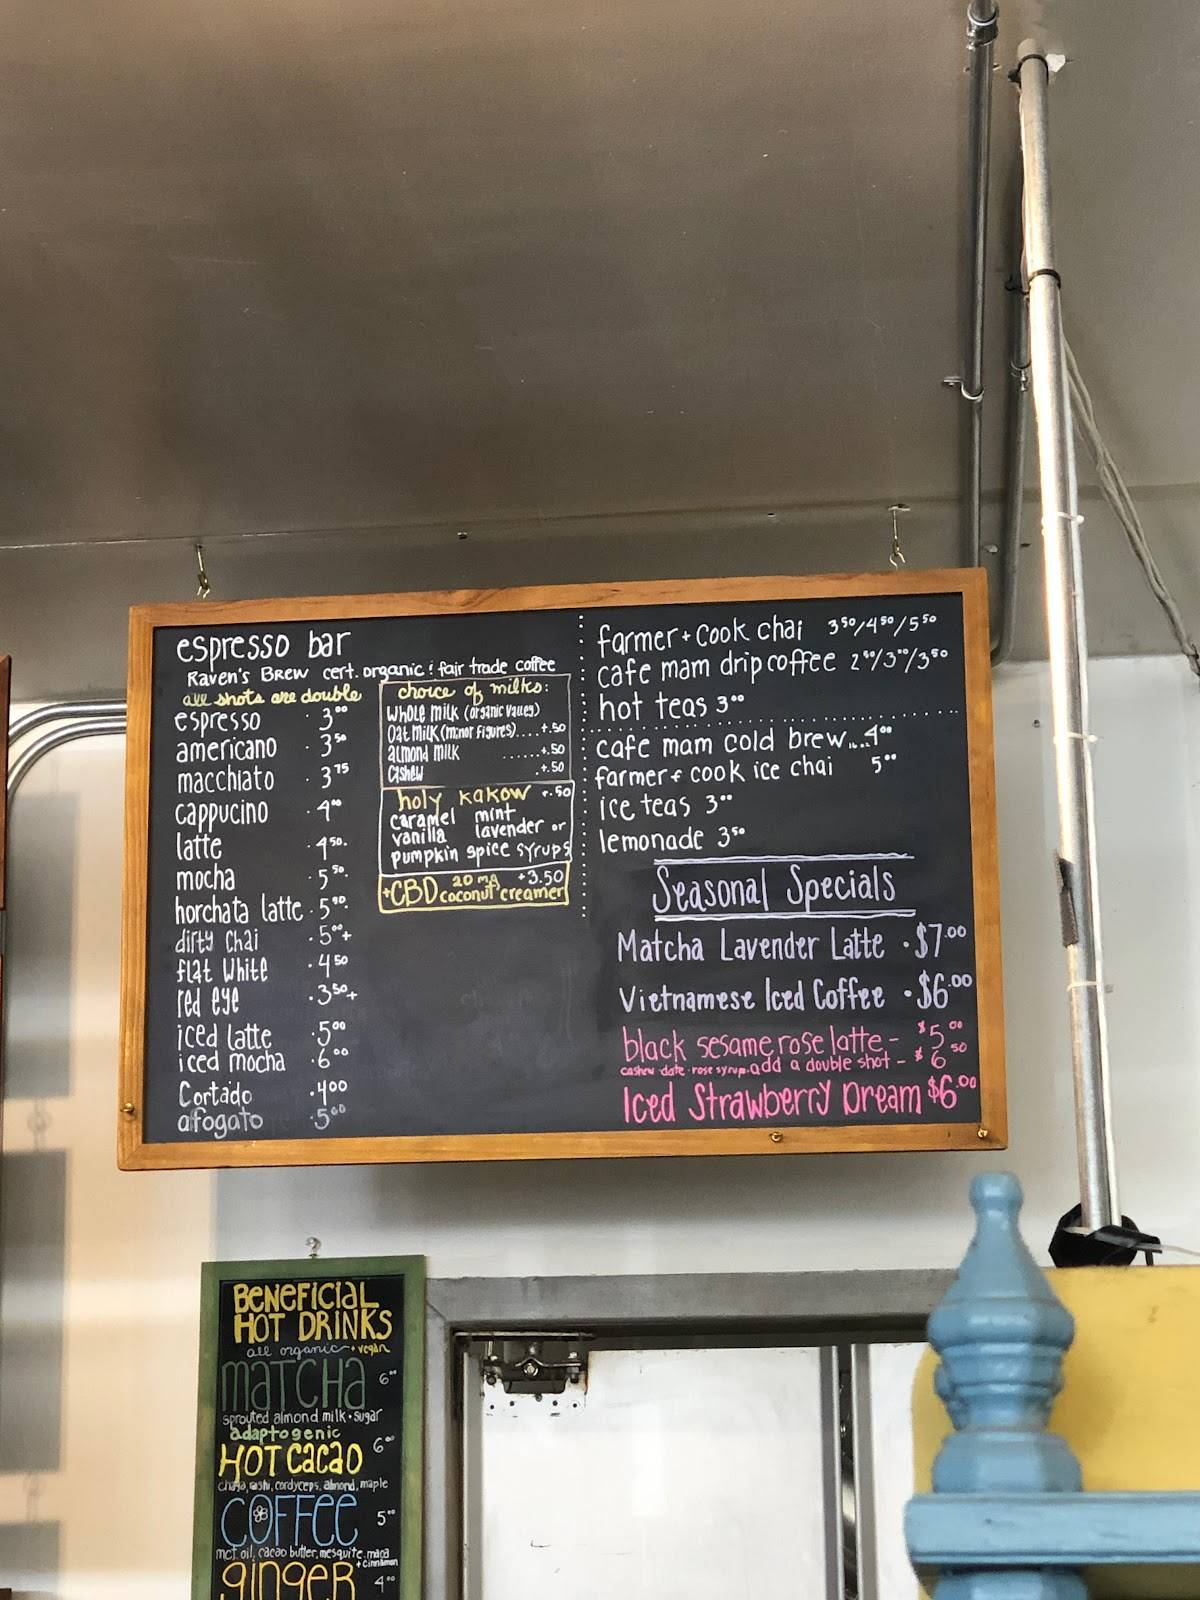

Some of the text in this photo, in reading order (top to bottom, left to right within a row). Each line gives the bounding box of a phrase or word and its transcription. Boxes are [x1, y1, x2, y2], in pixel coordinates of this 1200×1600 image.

[757, 615, 803, 641] chai
[177, 631, 351, 672] espresso bar
[188, 669, 250, 687] Raven's
[322, 662, 359, 680] cert.
[363, 663, 425, 683] organic
[438, 661, 464, 677] fair
[469, 657, 508, 674] trade
[515, 656, 556, 672] coffee
[598, 656, 652, 689] cafe
[662, 658, 710, 680] mam
[183, 683, 362, 707] all shots are double
[398, 681, 455, 700] choice
[464, 681, 484, 706] of
[599, 691, 643, 721] hot
[654, 691, 707, 719] teas
[175, 711, 260, 738] espresso
[177, 737, 277, 762] americano
[388, 744, 428, 763] almond
[596, 734, 650, 759] cafe
[662, 738, 713, 758] mam
[724, 727, 774, 753] cold
[789, 728, 848, 750] brew
[178, 764, 274, 793] macchiato
[753, 760, 780, 780] ice
[790, 755, 834, 777] chai
[175, 799, 268, 832] cappucino
[397, 789, 443, 818] holy
[459, 785, 532, 806] kakow
[600, 798, 636, 820] ice
[640, 793, 691, 817] teas
[390, 802, 516, 830] caramel mint
[392, 818, 566, 846] vanilla lavender or
[599, 827, 704, 853] lemonade
[177, 832, 222, 861] latte
[391, 841, 571, 870] pumpkin spice syrups
[177, 863, 235, 890] mocha
[452, 875, 473, 886] 20
[653, 864, 896, 914] Seasonal Specials
[439, 884, 495, 902] coconut
[500, 885, 563, 901] creamer
[175, 893, 303, 924] horchata latte
[175, 929, 214, 953] dirty
[618, 929, 705, 962] Matcha
[721, 927, 819, 961] Lavender
[832, 927, 885, 960] Latte
[176, 959, 212, 984] flat
[178, 986, 239, 1018] red eye
[619, 985, 755, 1013] Vietnamese
[766, 977, 805, 1011] Iced
[813, 977, 886, 1010] Coffee
[178, 1024, 217, 1050] iced
[227, 1023, 272, 1051] latte
[623, 1025, 882, 1063] black sesame rose latte
[179, 1050, 219, 1073] iced
[229, 1050, 285, 1073] mocha
[790, 1060, 800, 1071] a
[806, 1055, 852, 1071] double
[857, 1054, 889, 1069] shot
[179, 1080, 252, 1108] Cortado
[624, 1081, 675, 1124] Iced
[688, 1079, 832, 1121] Strawberry
[843, 1083, 922, 1116] Dream
[234, 1309, 393, 1344] HOT DRINKS
[247, 1343, 391, 1360] all organic vegan
[223, 1408, 383, 1430] sprouted almond milk sugar
[229, 1427, 341, 1445] adaptogenic
[360, 1479, 388, 1492] maple
[258, 1548, 287, 1558] cacao
[367, 1548, 390, 1558] maca
